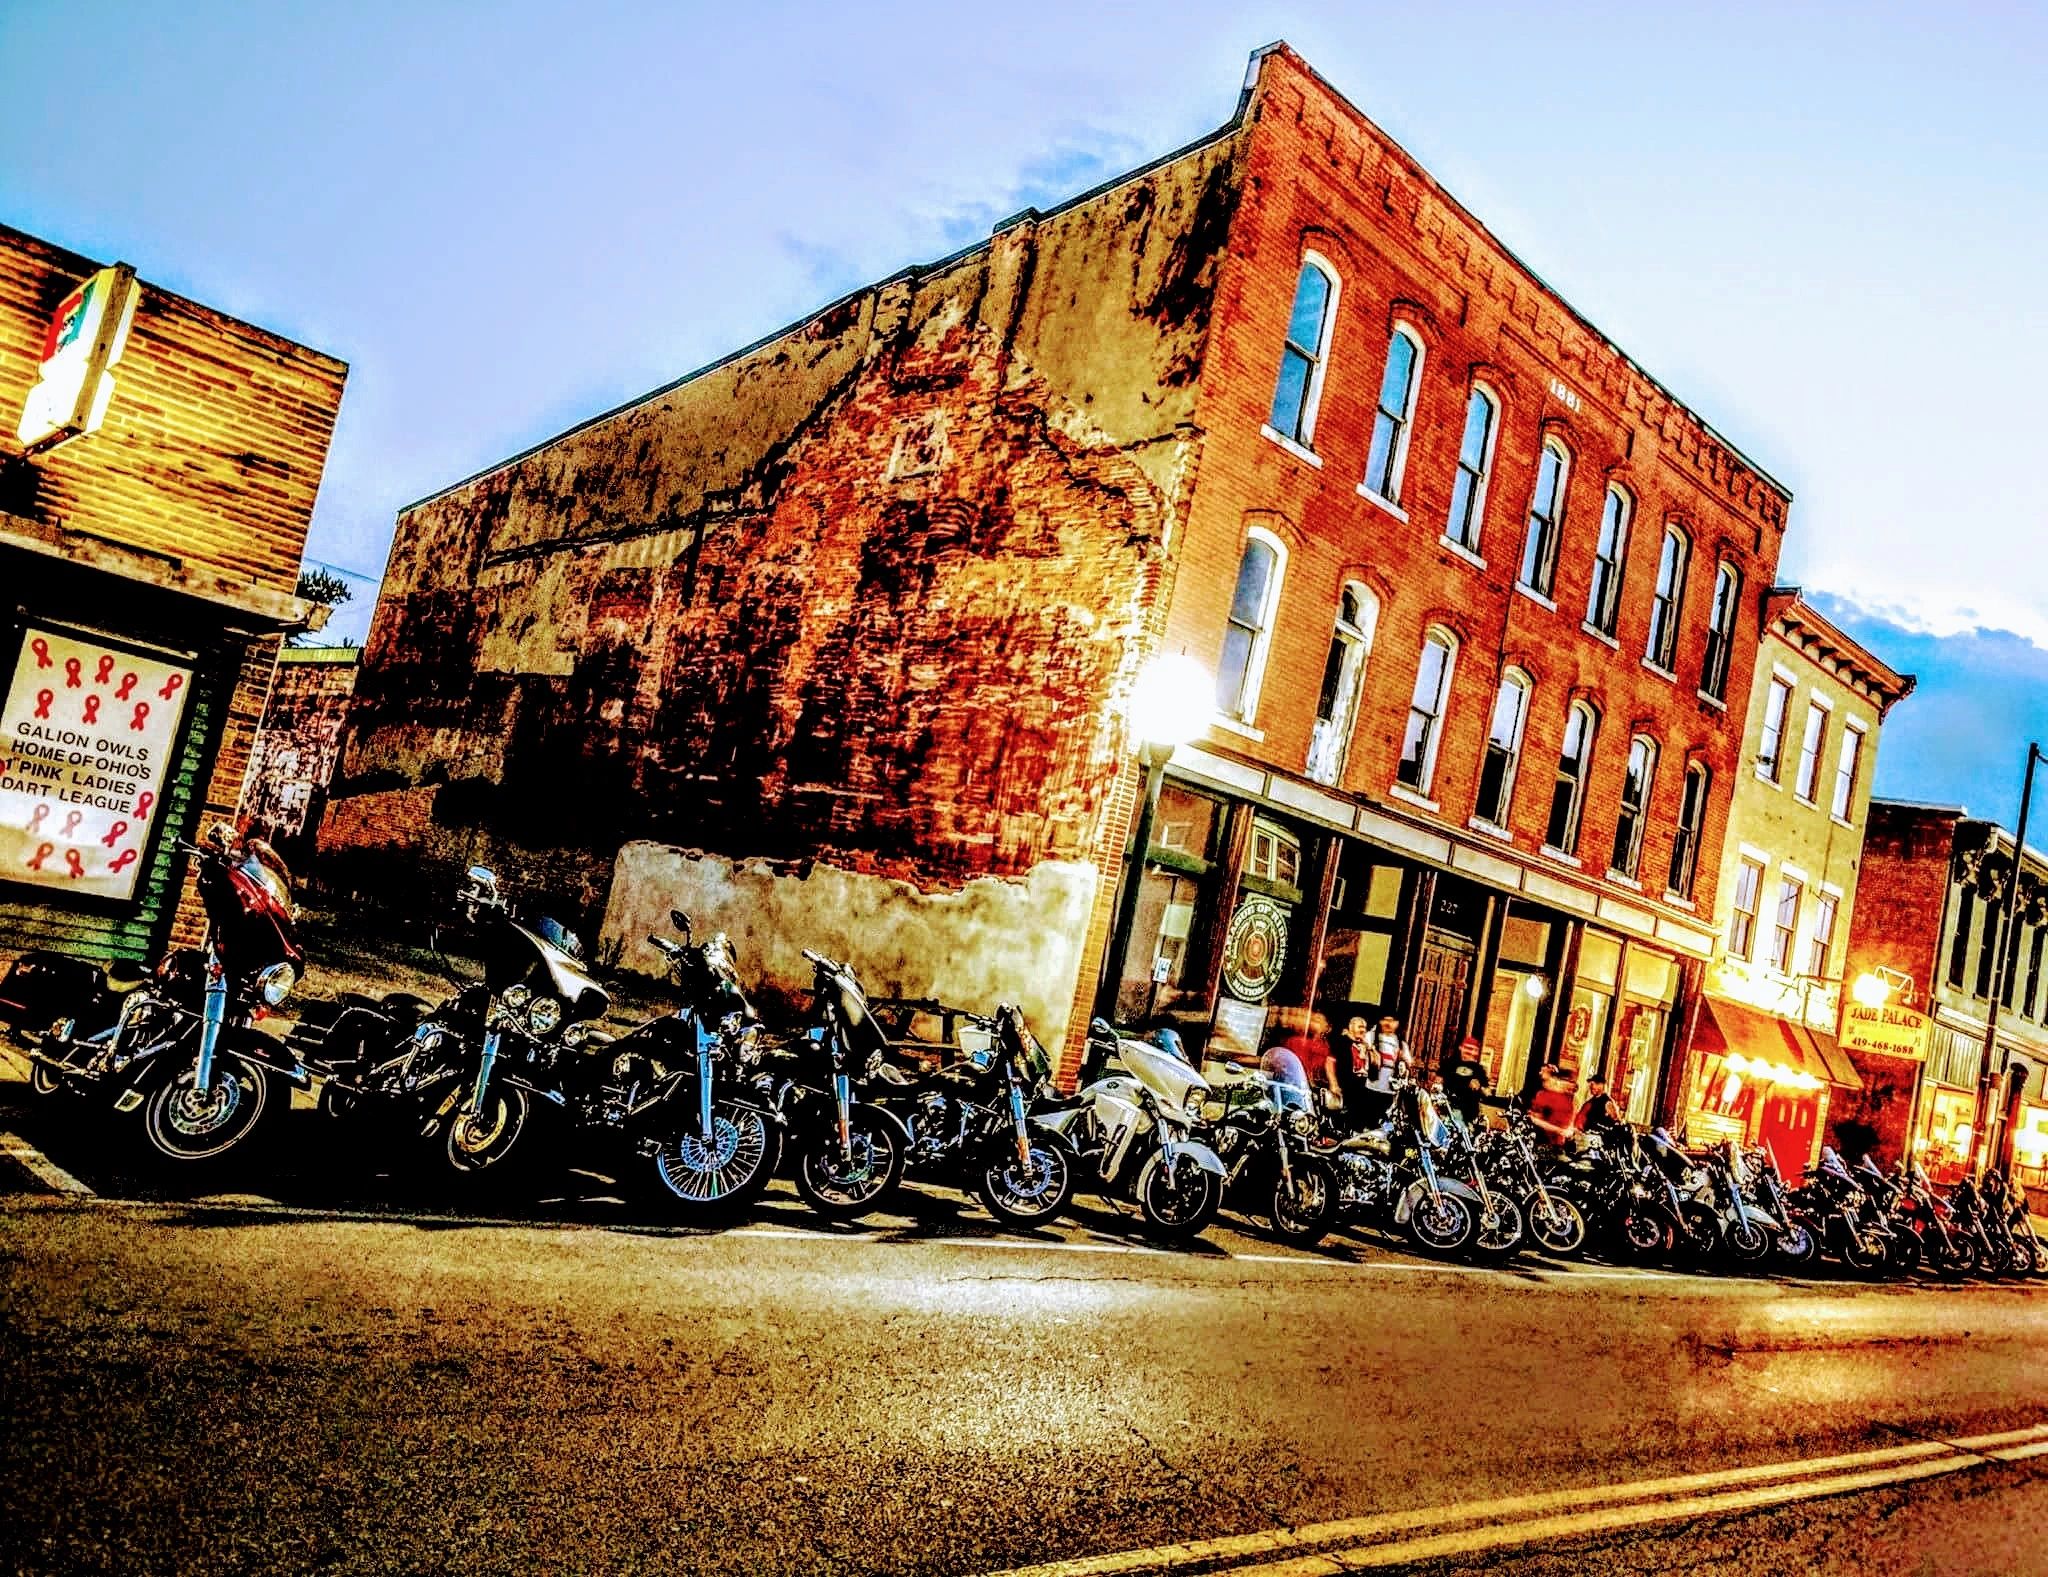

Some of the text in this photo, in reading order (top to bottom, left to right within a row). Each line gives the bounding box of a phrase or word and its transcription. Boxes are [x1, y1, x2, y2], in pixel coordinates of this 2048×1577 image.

[1550, 378, 1581, 413] 1881
[11, 739, 151, 779] HOME OF OHIO'S
[18, 722, 149, 761] GALION OWLS
[2, 777, 131, 813] DART LEAGUE
[19, 760, 63, 781] PINK
[72, 771, 136, 795] LADIES
[1851, 1008, 1878, 1021] JADE
[1881, 1008, 1922, 1028] PALACE
